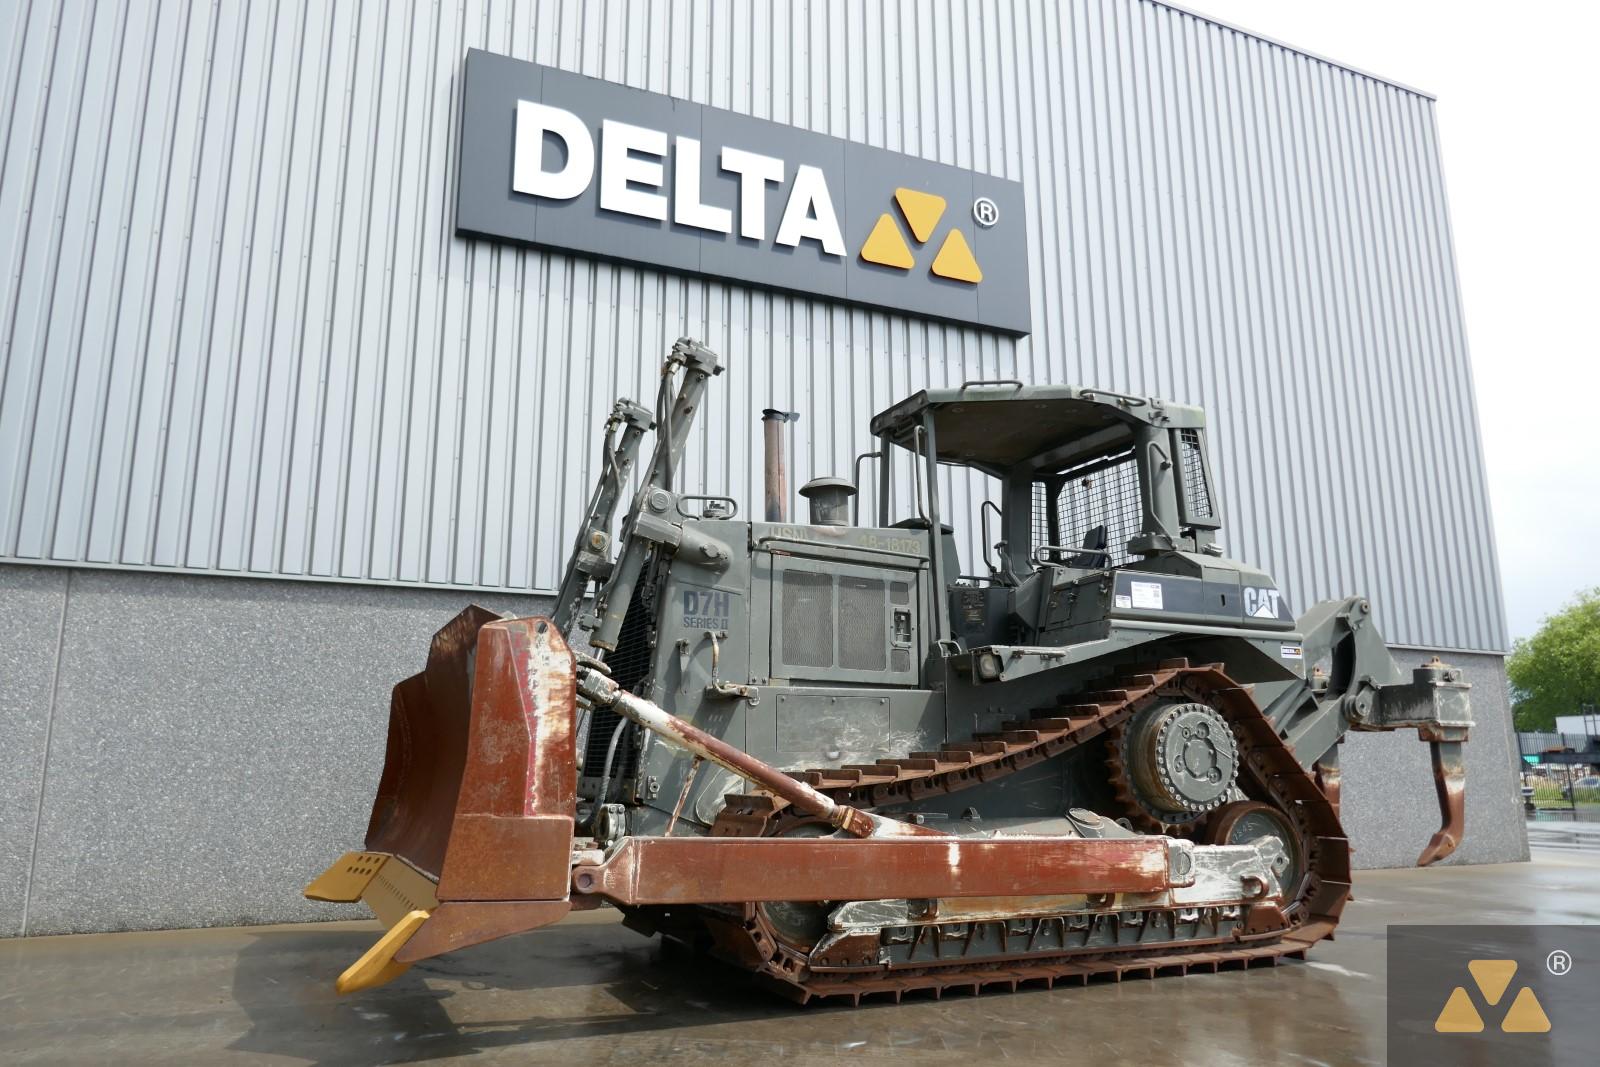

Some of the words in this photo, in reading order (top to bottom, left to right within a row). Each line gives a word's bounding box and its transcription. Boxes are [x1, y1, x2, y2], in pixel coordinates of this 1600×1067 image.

[512, 98, 847, 258] DELTA
[683, 591, 729, 616] D7H
[1243, 586, 1280, 619] CAT
[683, 617, 719, 630] SERIES
